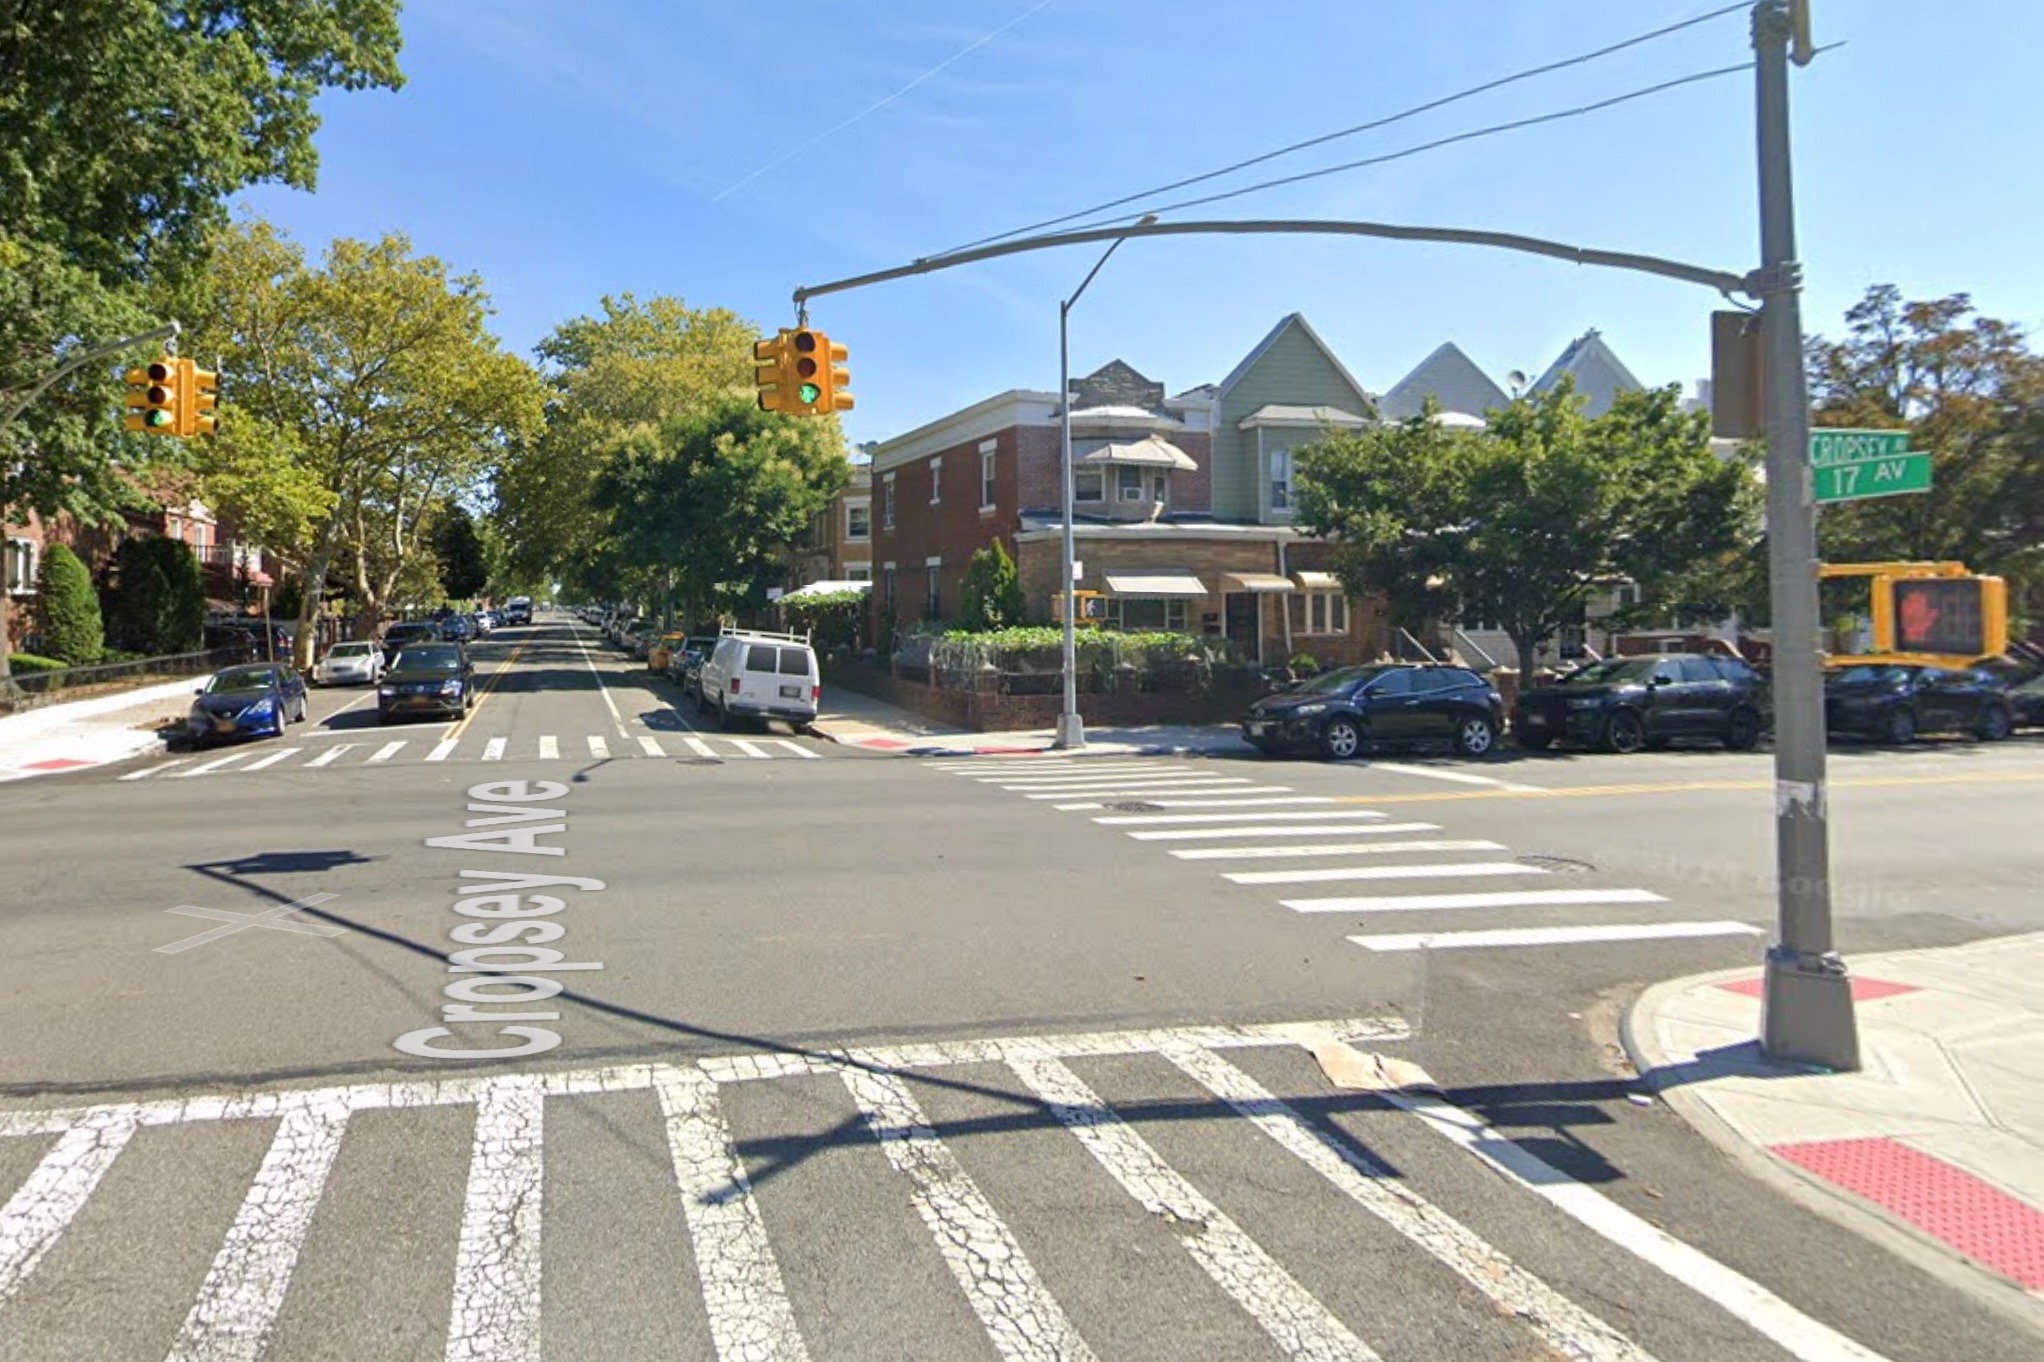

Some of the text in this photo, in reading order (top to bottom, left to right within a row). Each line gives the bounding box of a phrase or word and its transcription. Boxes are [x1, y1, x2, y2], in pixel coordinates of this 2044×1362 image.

[1810, 435, 1888, 463] CROPSEY
[1833, 460, 1907, 495] 17 AV
